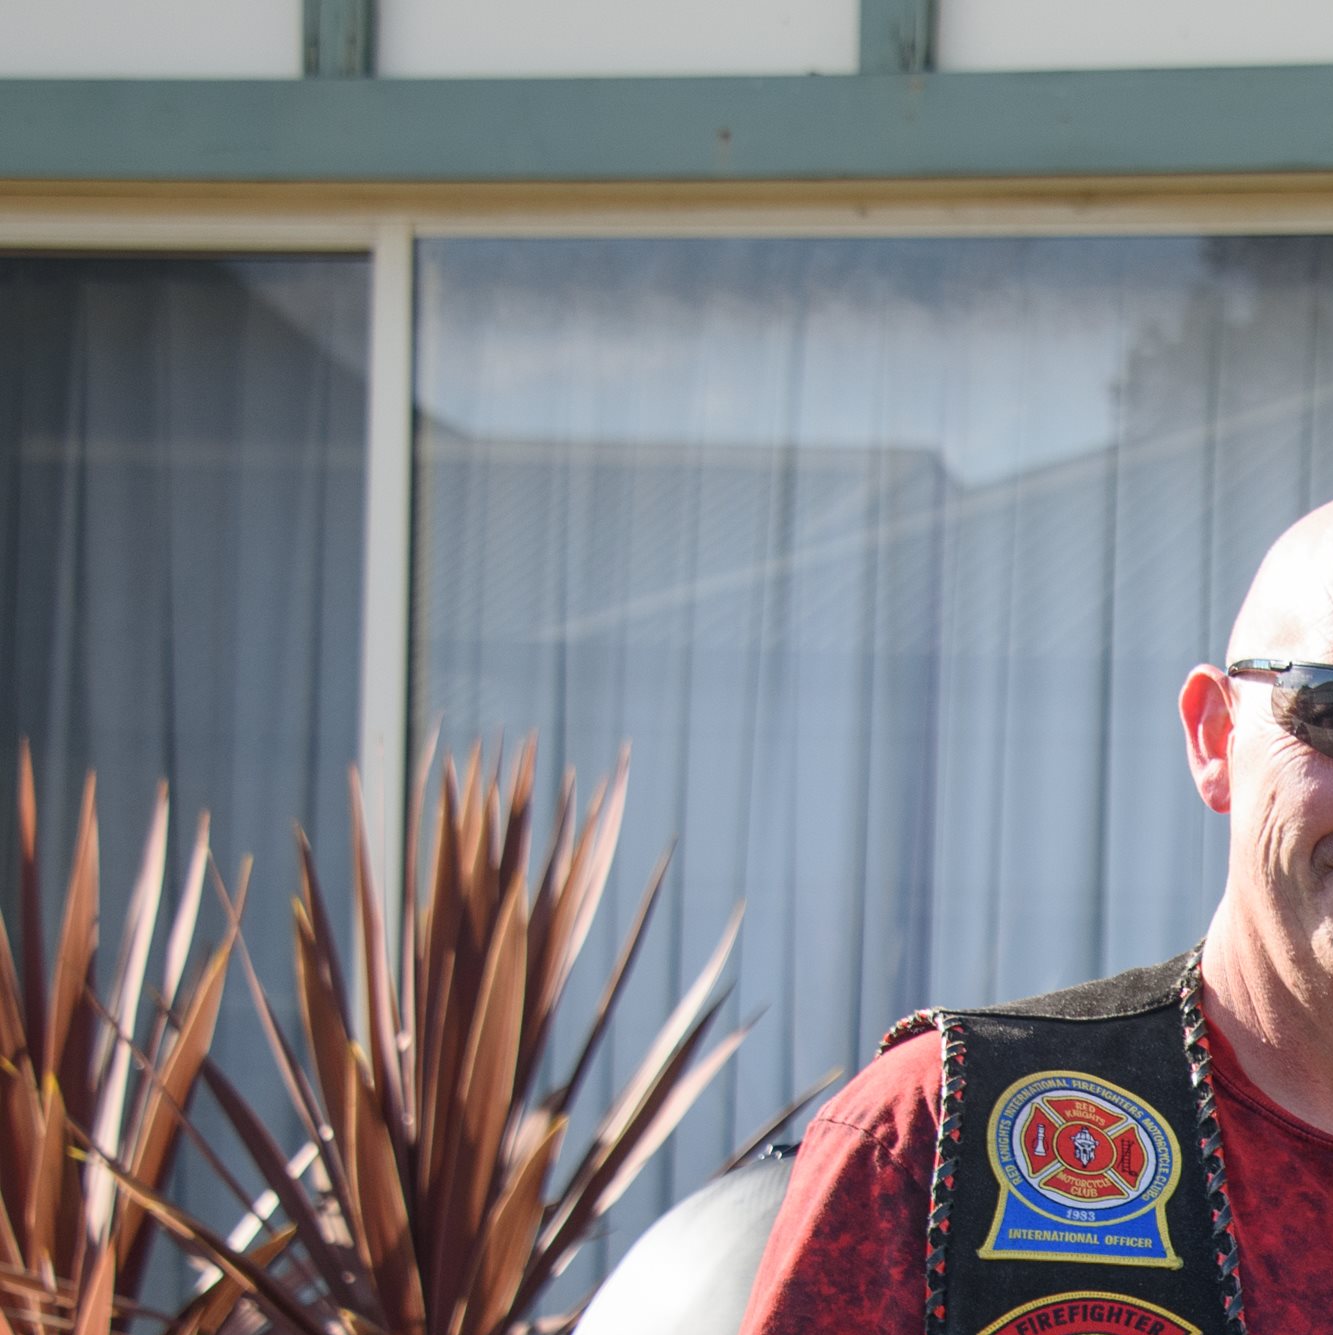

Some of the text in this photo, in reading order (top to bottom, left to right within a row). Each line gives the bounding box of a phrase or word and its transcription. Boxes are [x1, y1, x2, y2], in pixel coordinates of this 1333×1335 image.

[1004, 1079, 1070, 1118] INTERNATIONAL
[1071, 1079, 1145, 1119] FIREFIGHTERS
[1075, 1102, 1096, 1113] RED
[1065, 1109, 1106, 1126] KNIGHTS
[998, 1119, 1012, 1163] KNIGHTS
[1142, 1118, 1173, 1174] MOTORCYCLE
[1004, 1164, 1024, 1186] RED
[1057, 1172, 1111, 1189] MOTORCYCLE
[1070, 1187, 1099, 1198] CLUB
[1008, 1228, 1153, 1248] INTERNATIONAL OFFICER
